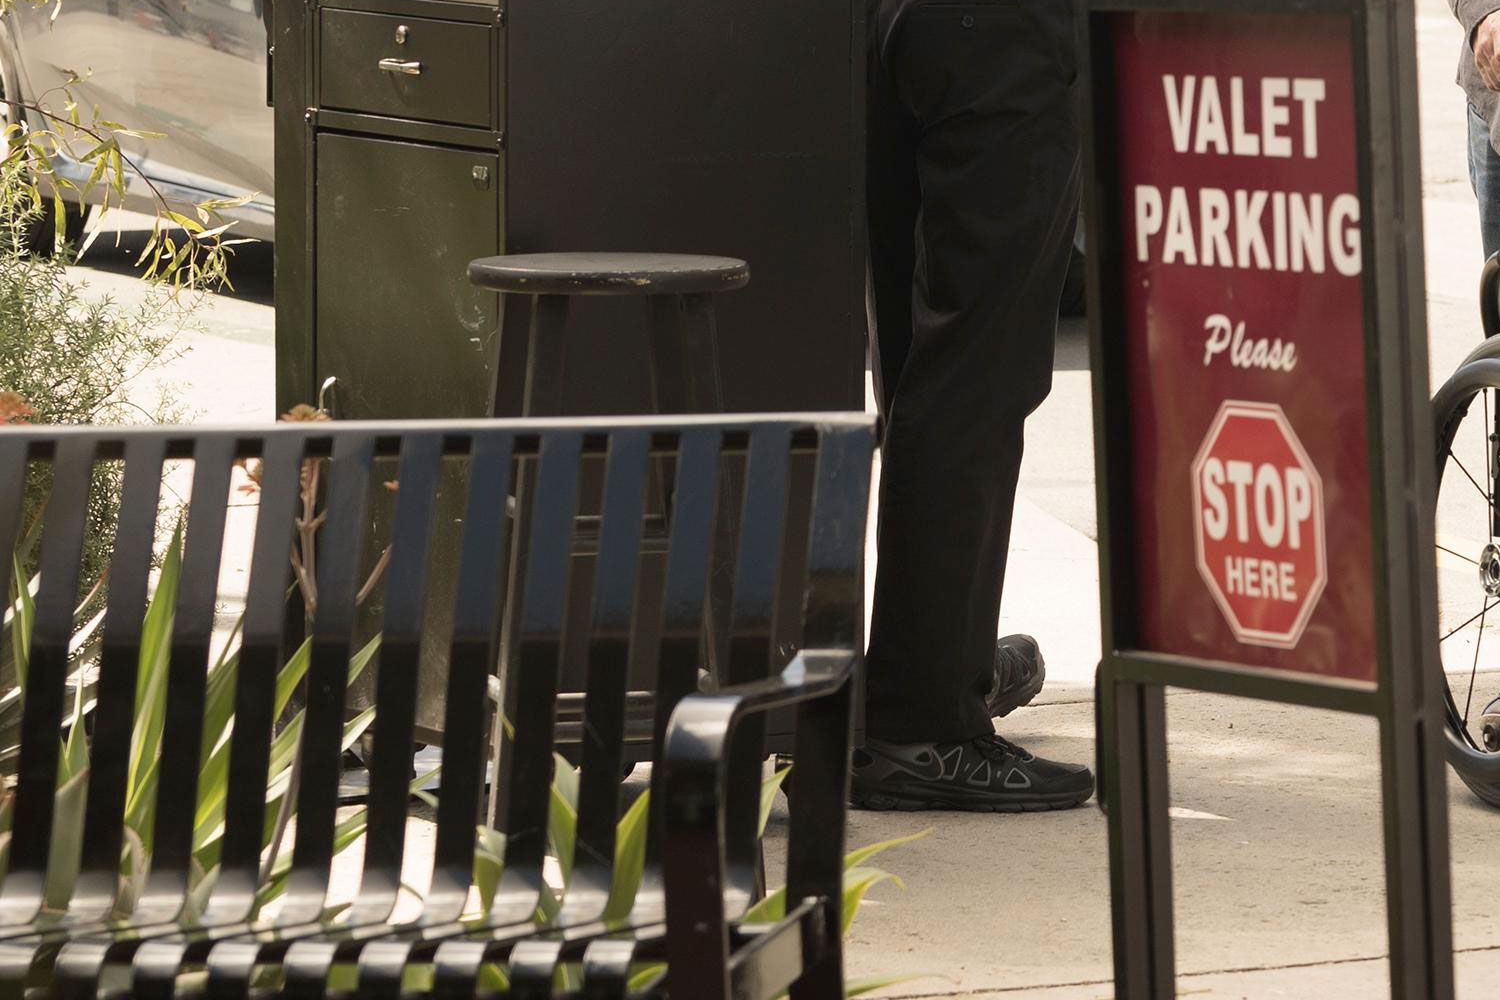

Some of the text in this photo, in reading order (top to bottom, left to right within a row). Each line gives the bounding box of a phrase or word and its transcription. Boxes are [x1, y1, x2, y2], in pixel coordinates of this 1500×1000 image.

[1162, 75, 1326, 158] VALET
[1135, 185, 1362, 276] PARKING
[1204, 314, 1297, 372] Please
[1203, 457, 1312, 549] STOP
[1225, 555, 1297, 601] HERE
